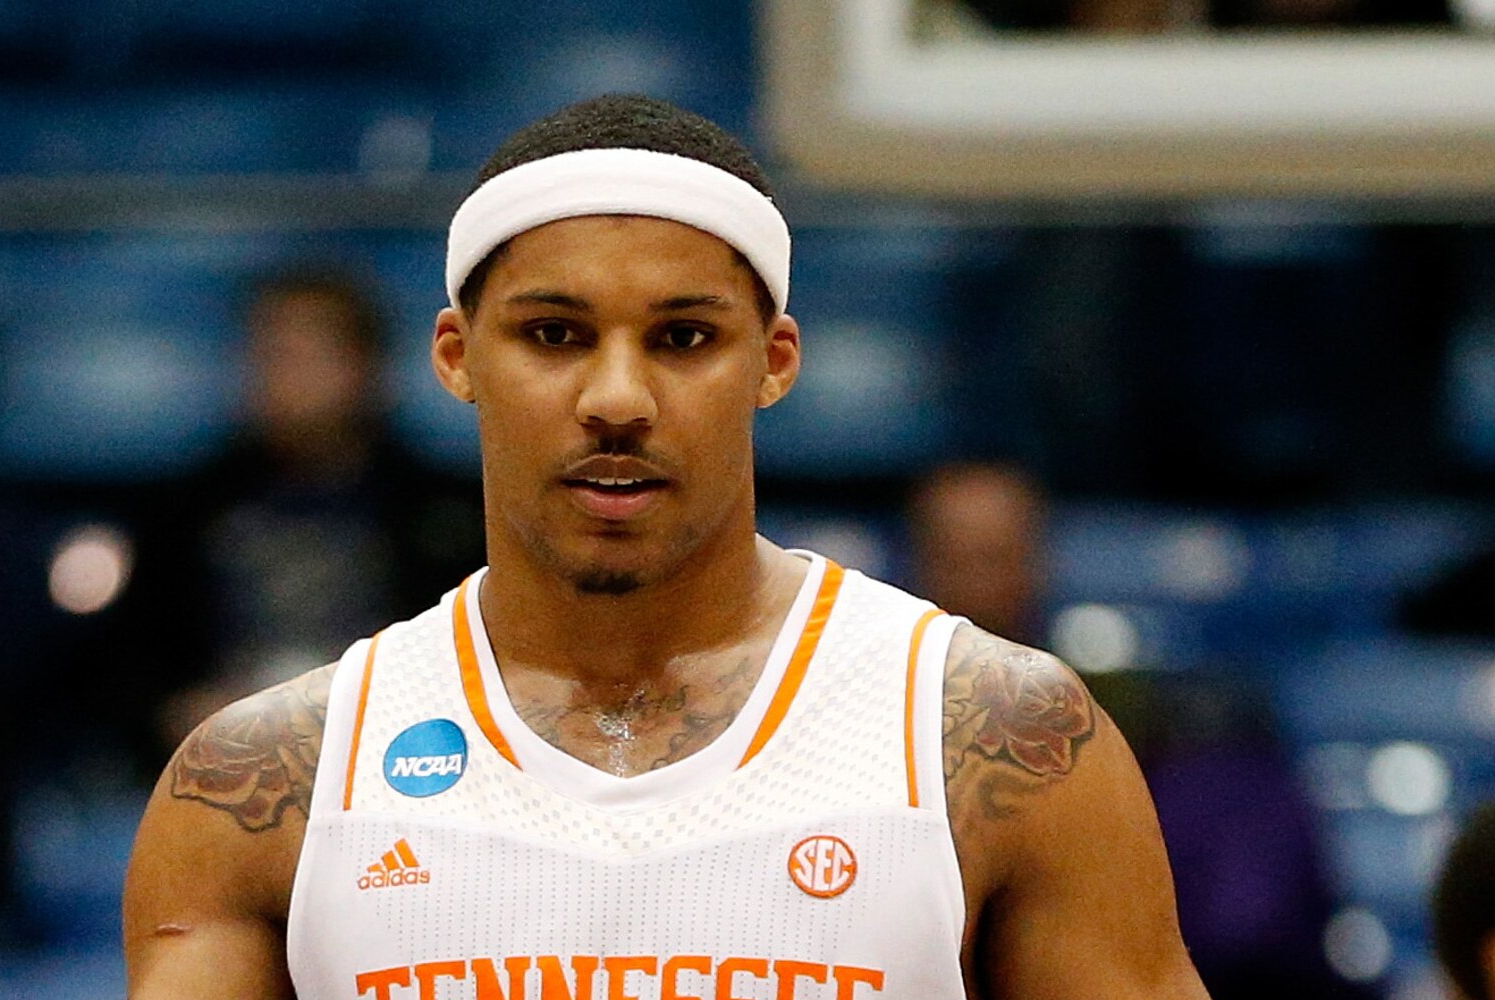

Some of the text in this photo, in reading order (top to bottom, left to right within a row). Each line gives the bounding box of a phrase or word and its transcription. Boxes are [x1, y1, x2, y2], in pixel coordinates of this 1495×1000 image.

[390, 753, 463, 778] NCAA
[357, 866, 431, 890] adidas
[793, 839, 853, 892] SEC
